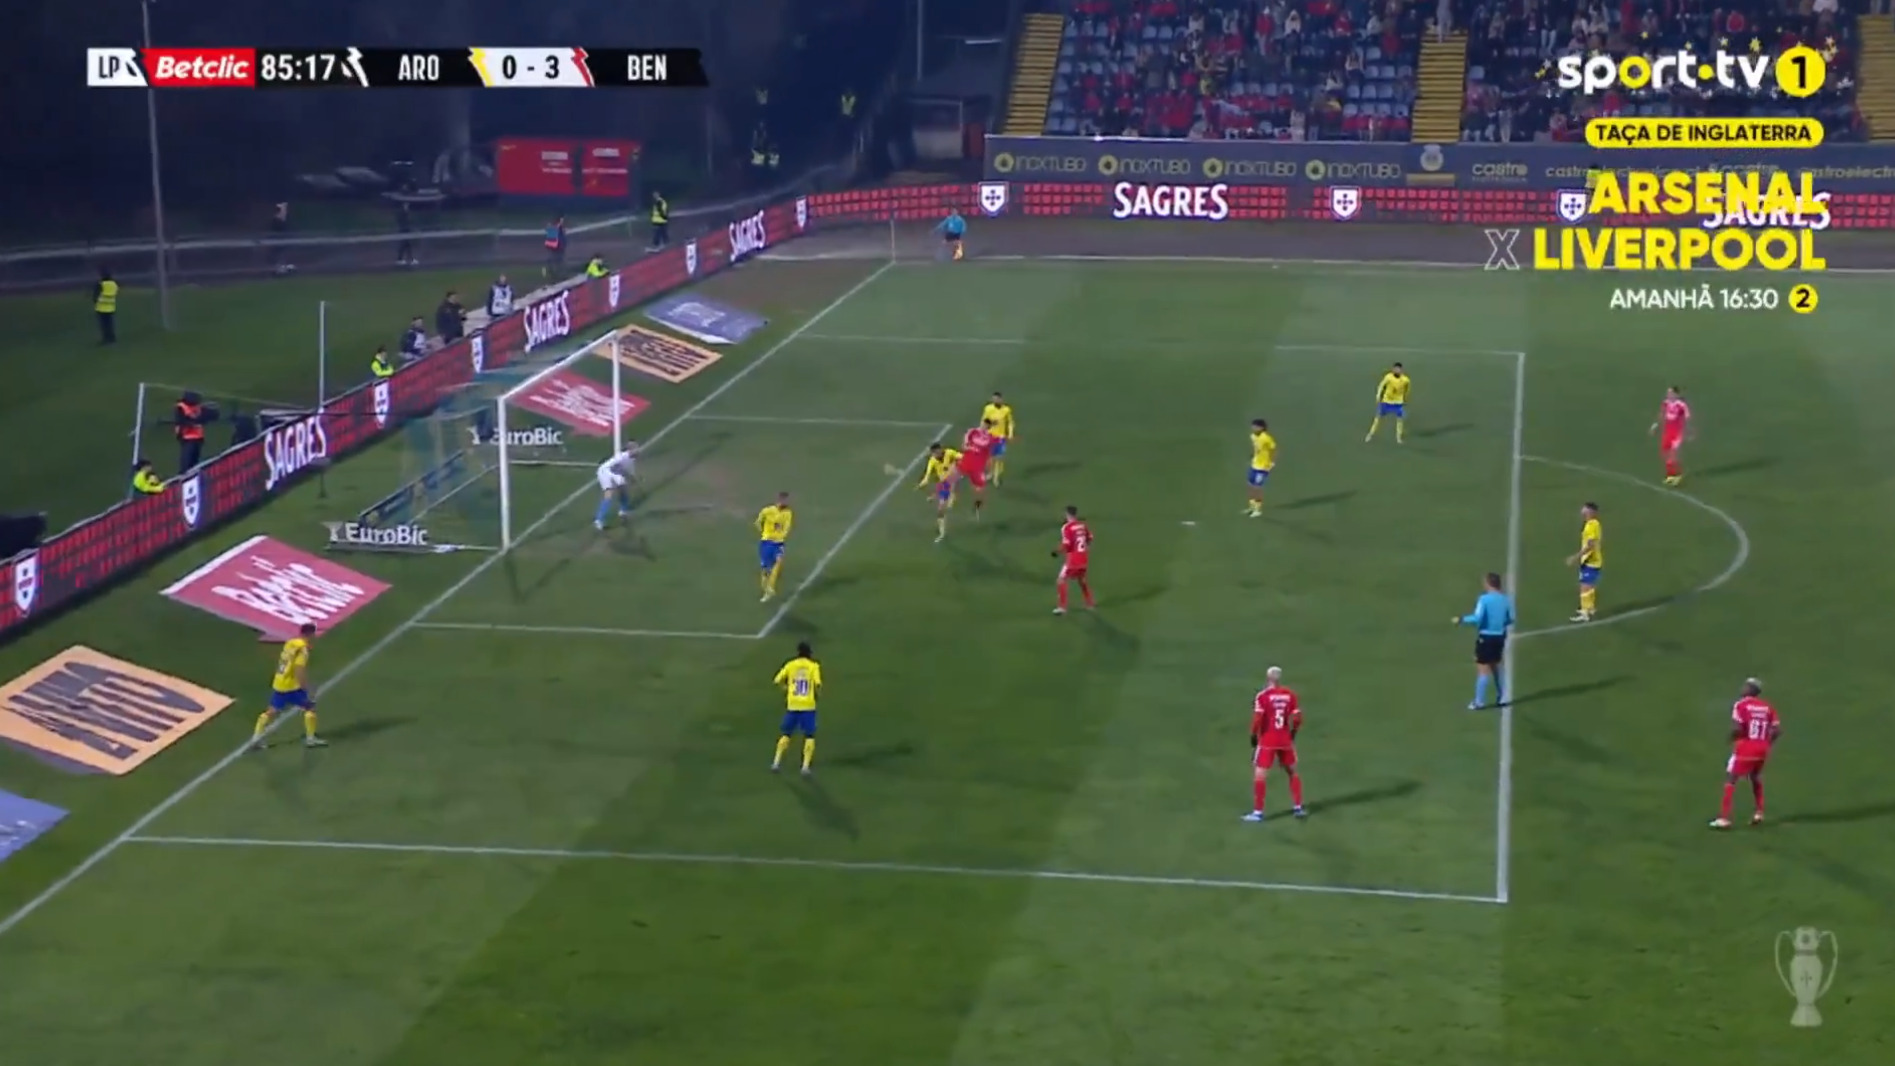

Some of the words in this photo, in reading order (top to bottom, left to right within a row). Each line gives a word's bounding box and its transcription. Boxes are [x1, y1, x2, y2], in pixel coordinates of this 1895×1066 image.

[1112, 182, 1230, 219] SAGRES
[729, 210, 766, 261] SAGRES
[524, 291, 570, 353] SAGRES
[265, 409, 326, 490] SAGRES
[345, 522, 428, 546] EuroBic
[1274, 708, 1284, 729] 5
